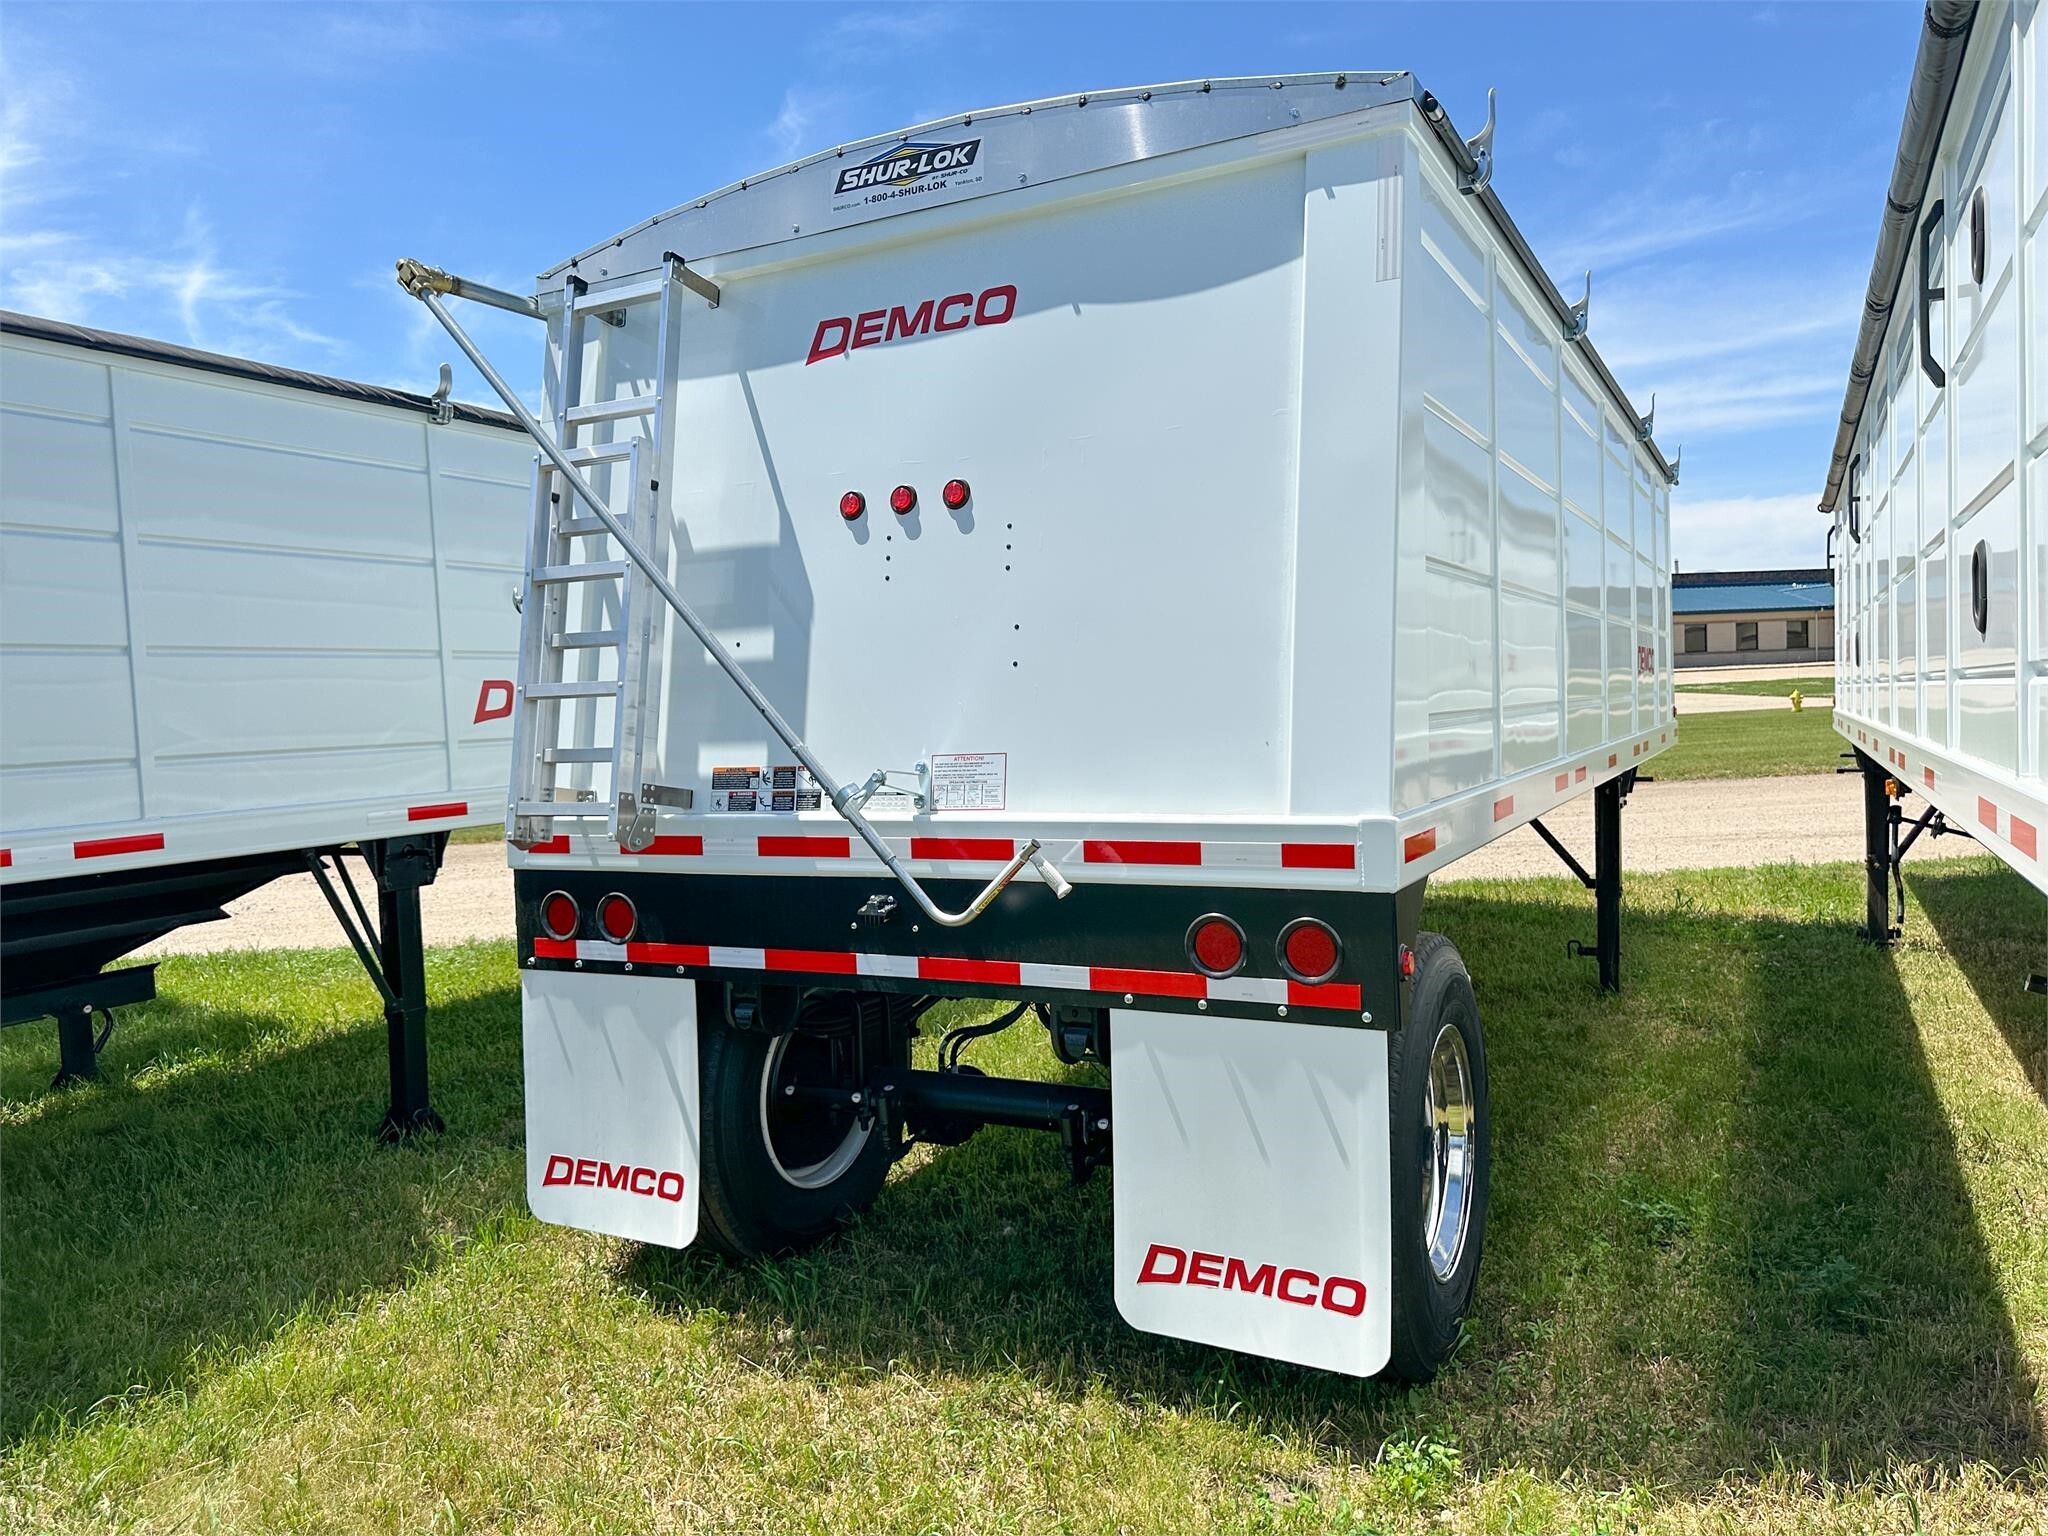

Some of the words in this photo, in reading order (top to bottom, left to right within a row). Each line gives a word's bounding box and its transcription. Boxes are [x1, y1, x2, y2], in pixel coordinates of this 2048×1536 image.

[840, 144, 974, 191] SHUR-LOK
[941, 168, 969, 178] SHUR-CO
[863, 179, 947, 205] 1-800-4-SHUR-LOK
[805, 284, 1018, 366] DEMCO
[542, 1154, 684, 1202] DEMCO
[1137, 1243, 1368, 1317] DEMCO
